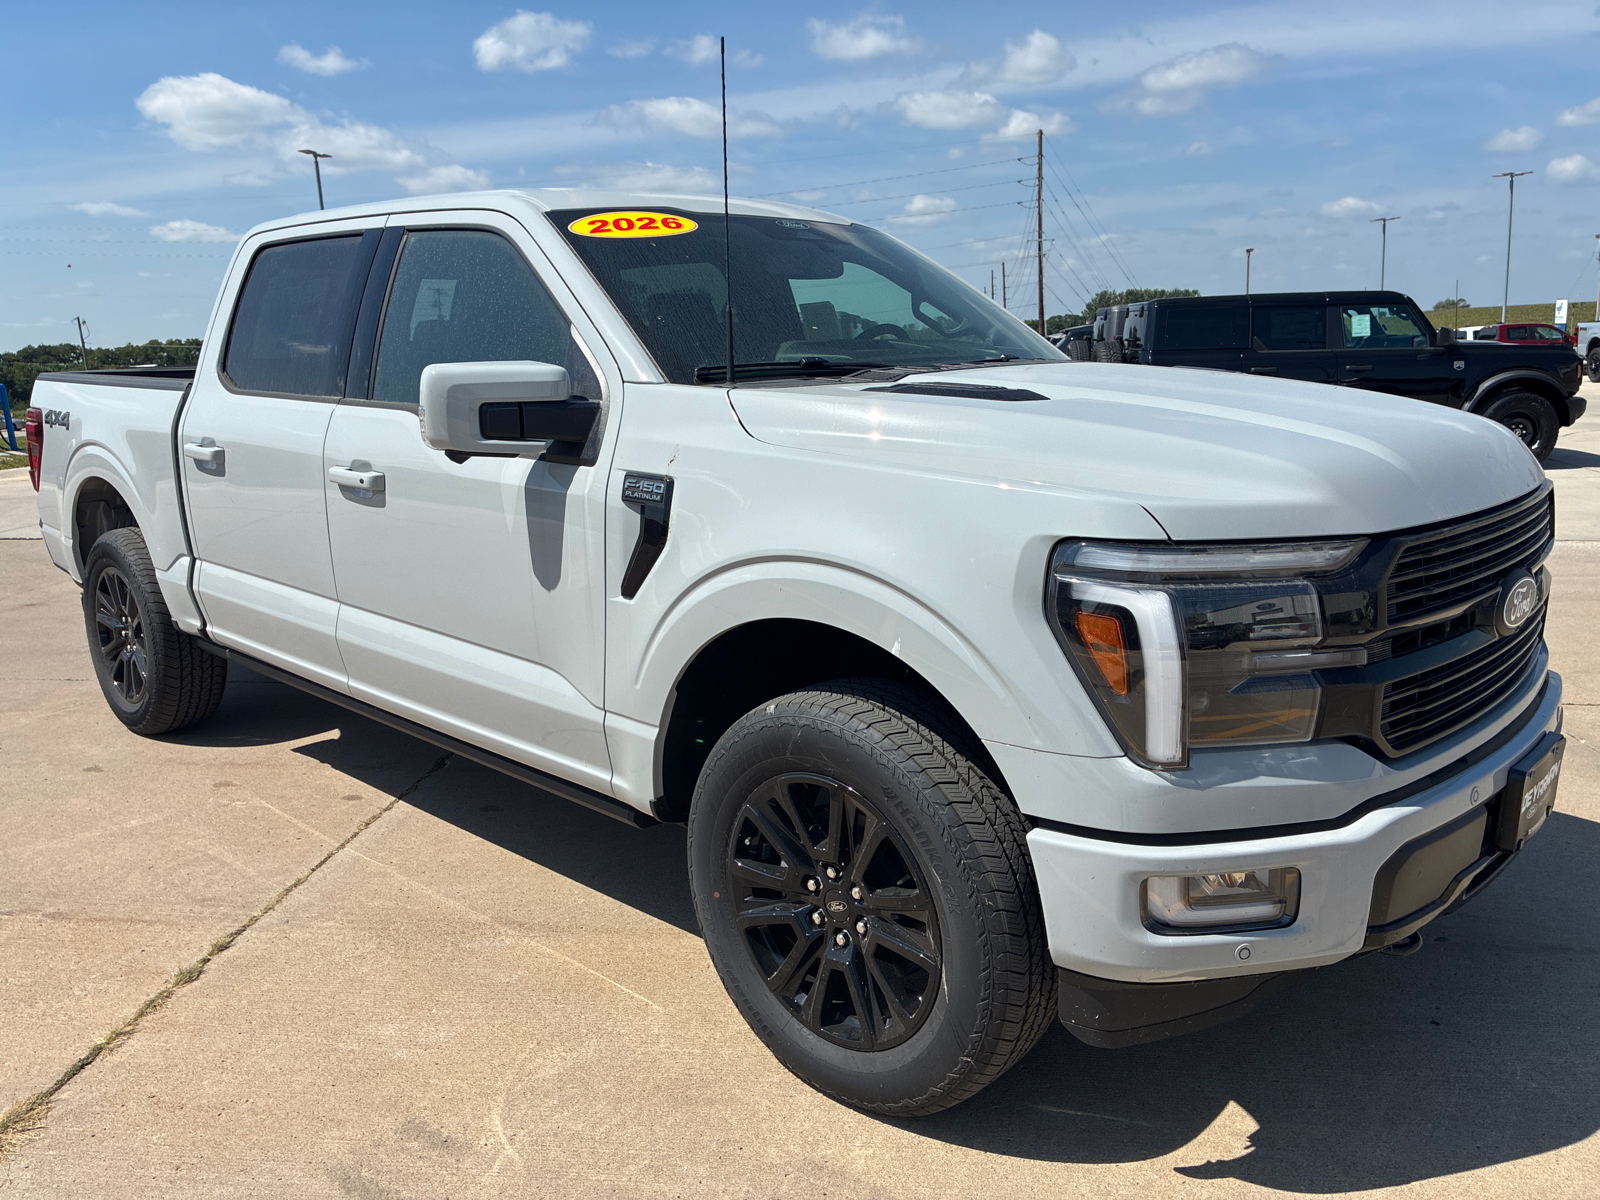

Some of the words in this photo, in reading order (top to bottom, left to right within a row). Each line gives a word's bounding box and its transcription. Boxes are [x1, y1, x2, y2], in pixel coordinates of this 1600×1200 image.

[587, 217, 684, 234] 2026
[625, 478, 665, 494] F-150
[625, 490, 660, 501] PLATINUM
[1509, 584, 1533, 623] Ford
